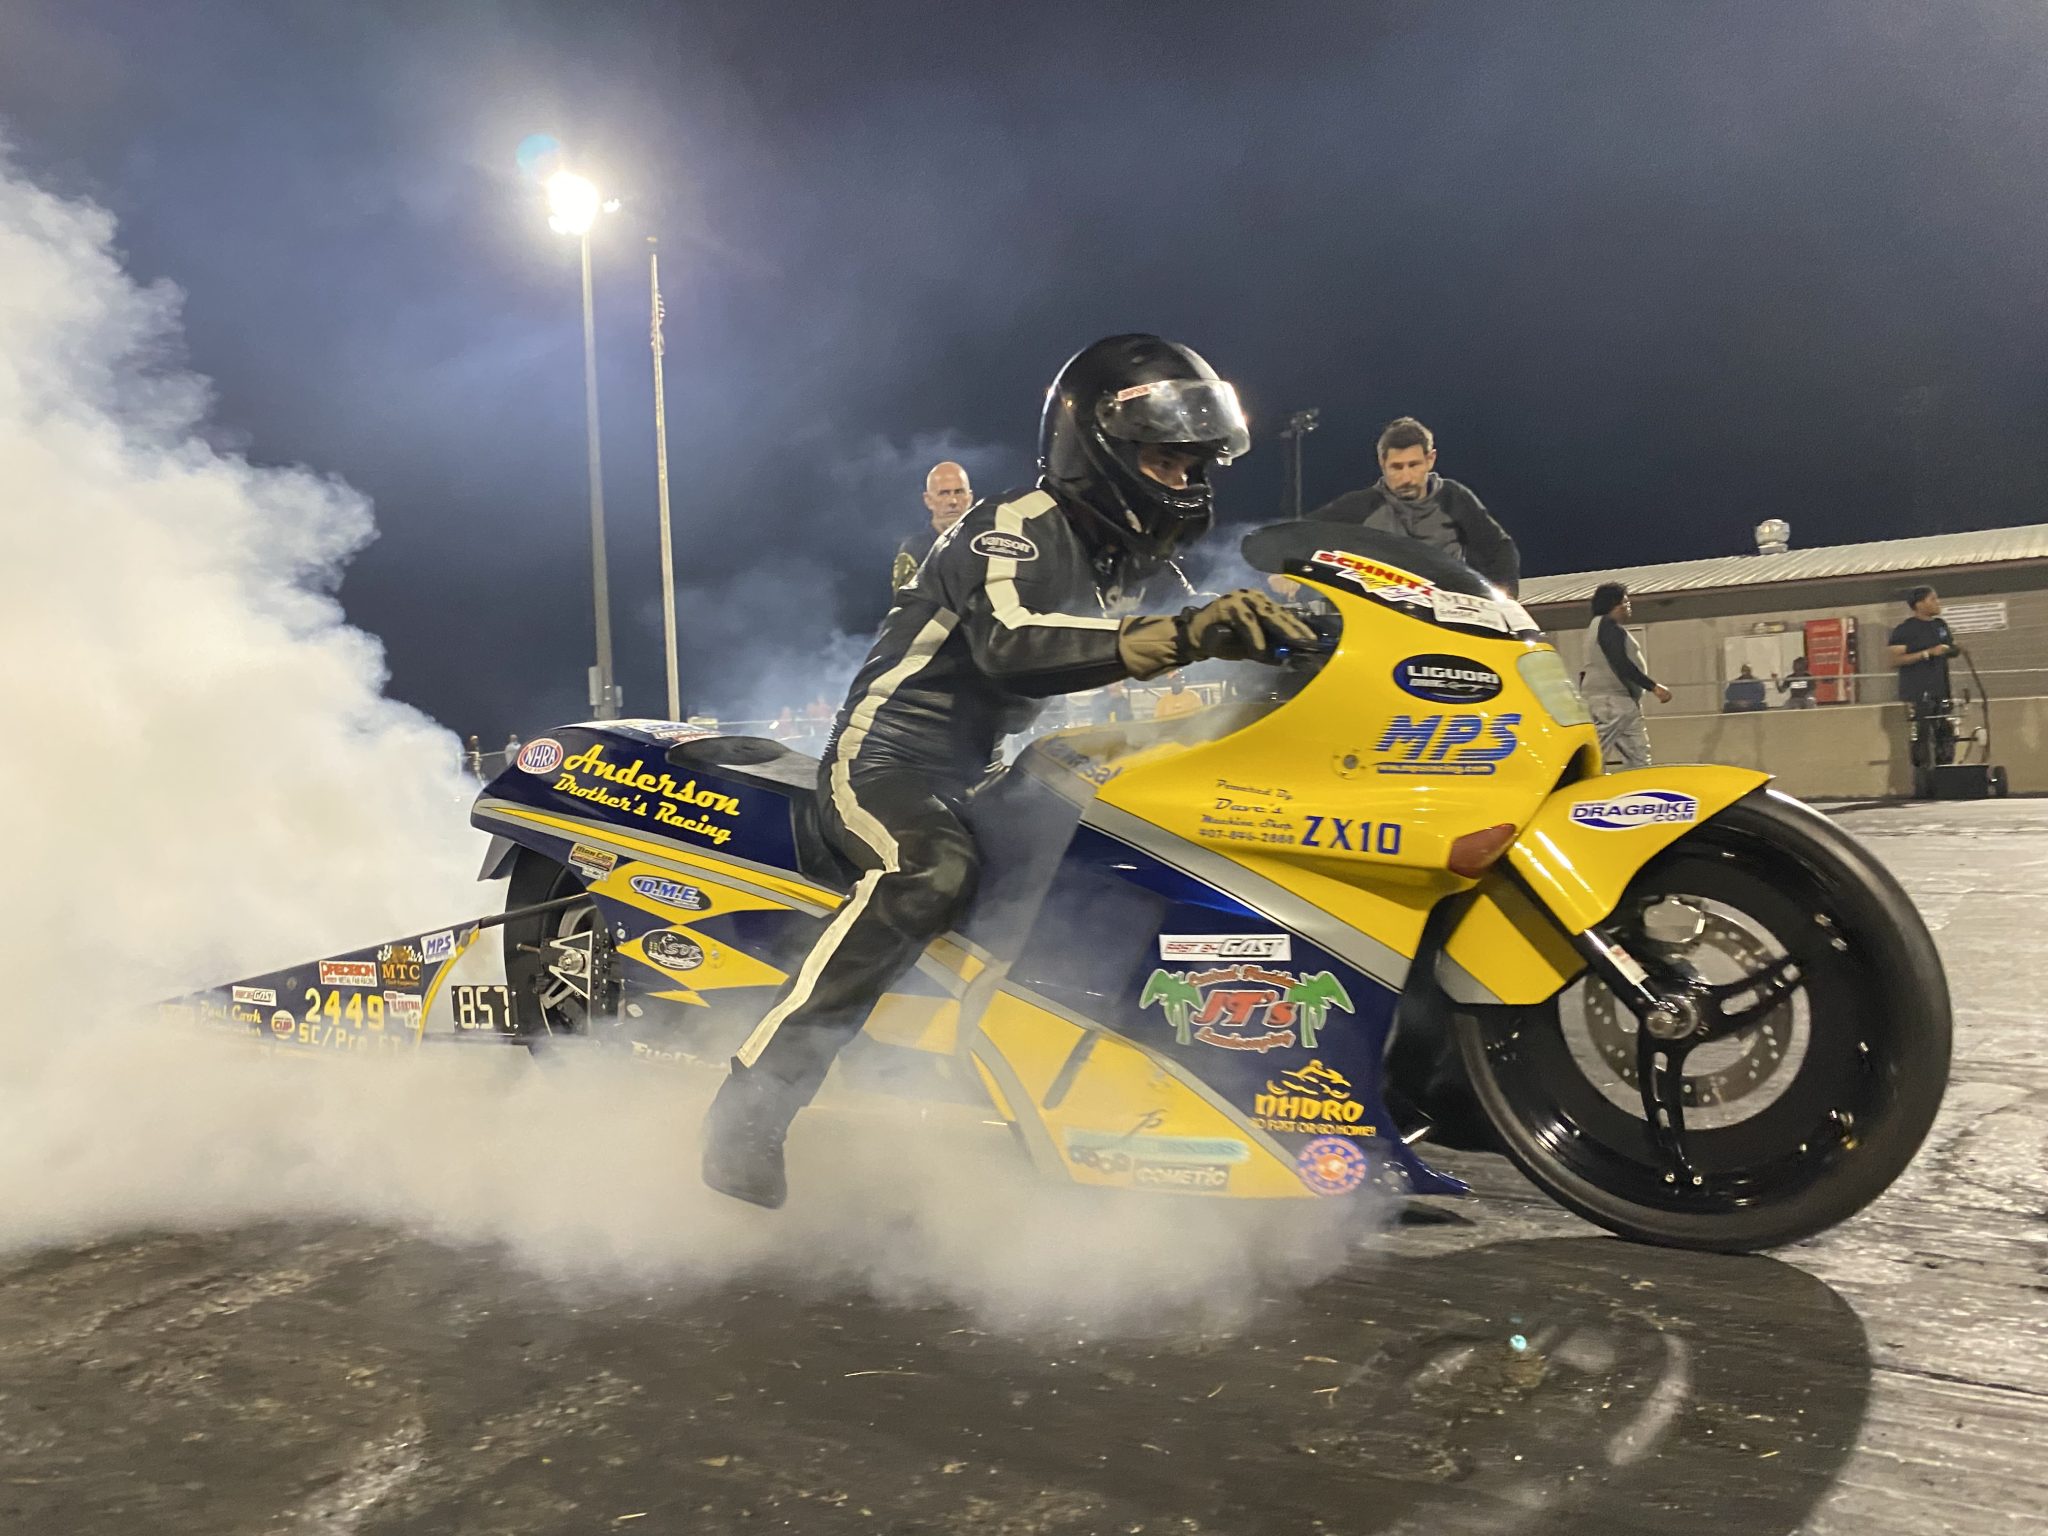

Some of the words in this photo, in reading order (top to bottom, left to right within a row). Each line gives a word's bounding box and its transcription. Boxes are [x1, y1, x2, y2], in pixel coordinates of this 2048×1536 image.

[1373, 713, 1522, 761] MPS
[525, 746, 556, 768] NHRA
[563, 744, 740, 816] Anderson
[553, 773, 647, 817] Brother's
[654, 802, 731, 845] Racing
[1573, 801, 1696, 818] DRAGBIKE
[1301, 815, 1402, 855] ZX10
[427, 935, 452, 956] MPS
[381, 963, 421, 980] MTC
[304, 987, 385, 1032] 2449
[1254, 1093, 1365, 1123] NHDRO
